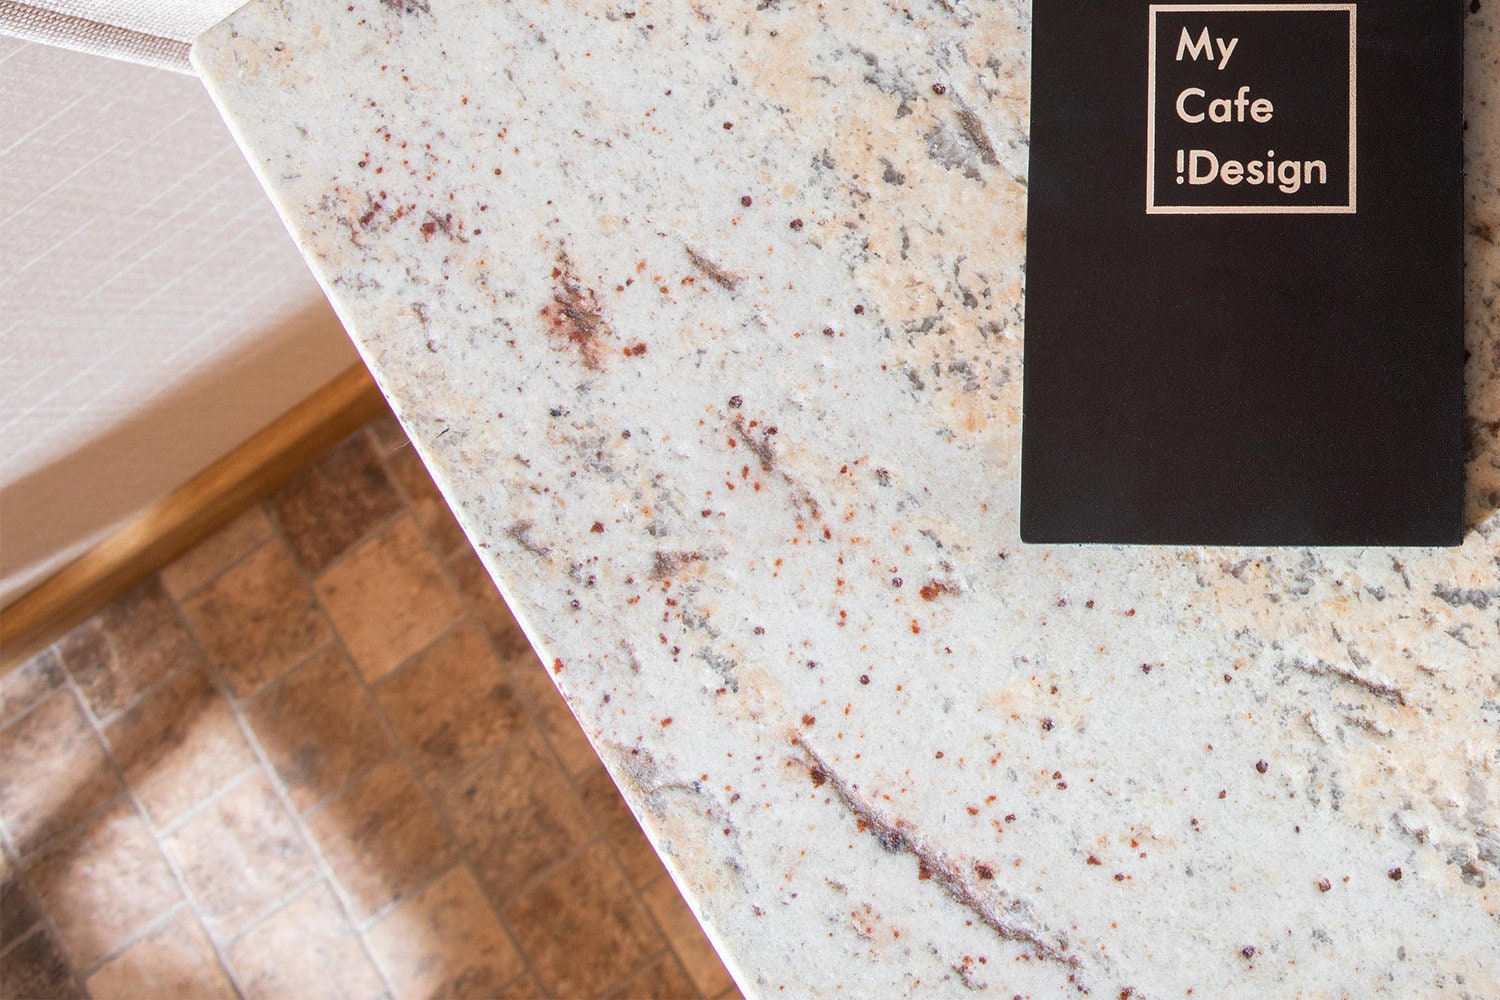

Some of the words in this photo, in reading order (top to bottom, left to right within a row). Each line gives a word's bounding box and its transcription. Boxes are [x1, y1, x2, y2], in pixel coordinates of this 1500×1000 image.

[1175, 26, 1239, 70] My
[1175, 85, 1274, 124] Cafe
[1176, 149, 1327, 194] !Design
